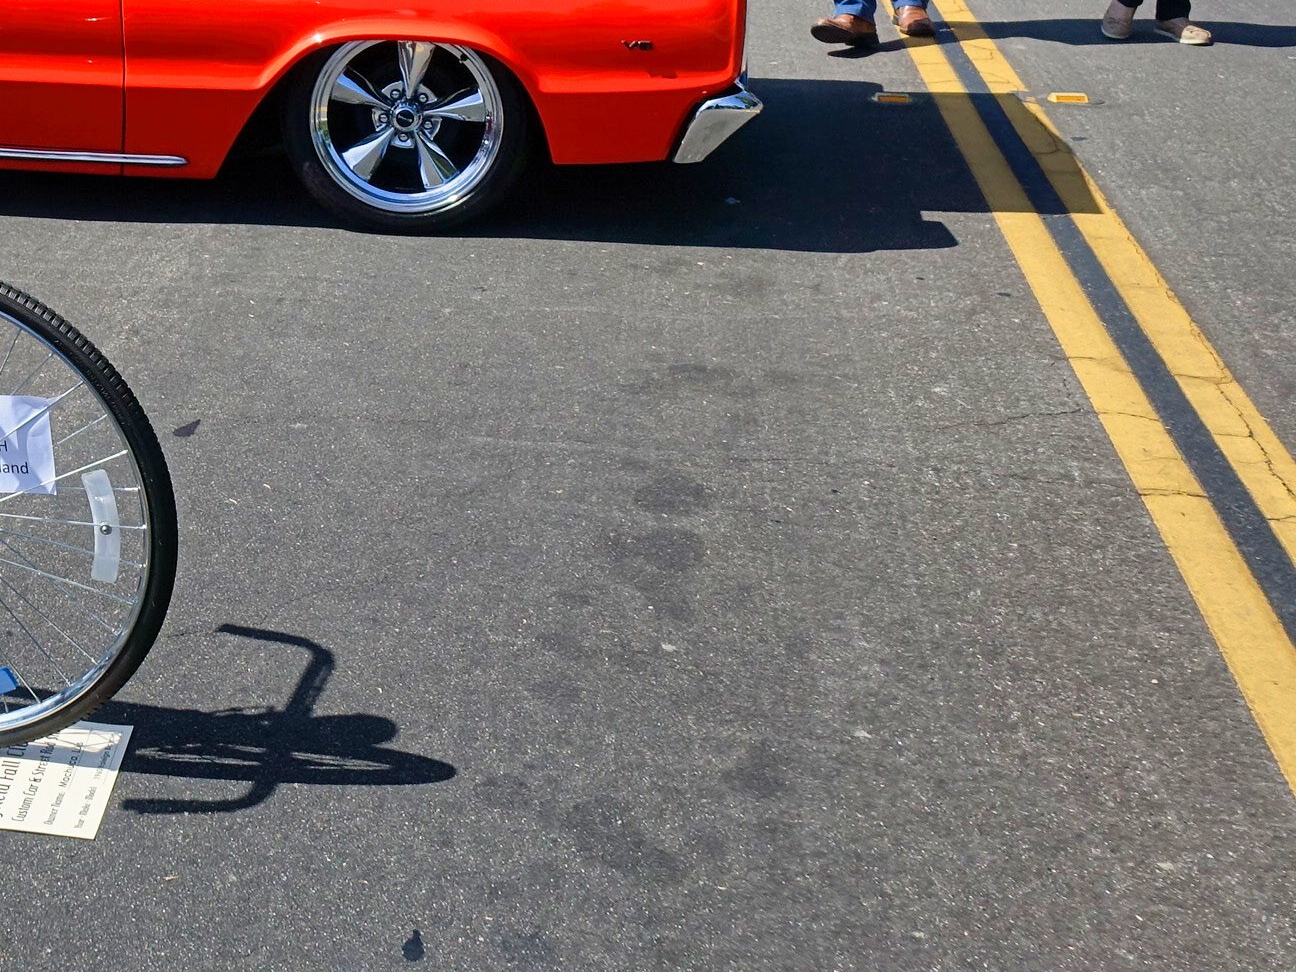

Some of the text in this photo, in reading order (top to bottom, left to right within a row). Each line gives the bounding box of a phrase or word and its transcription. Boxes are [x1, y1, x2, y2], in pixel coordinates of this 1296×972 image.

[11, 797, 34, 823] Custom
[23, 784, 39, 797] Car
[32, 755, 51, 776] Street
